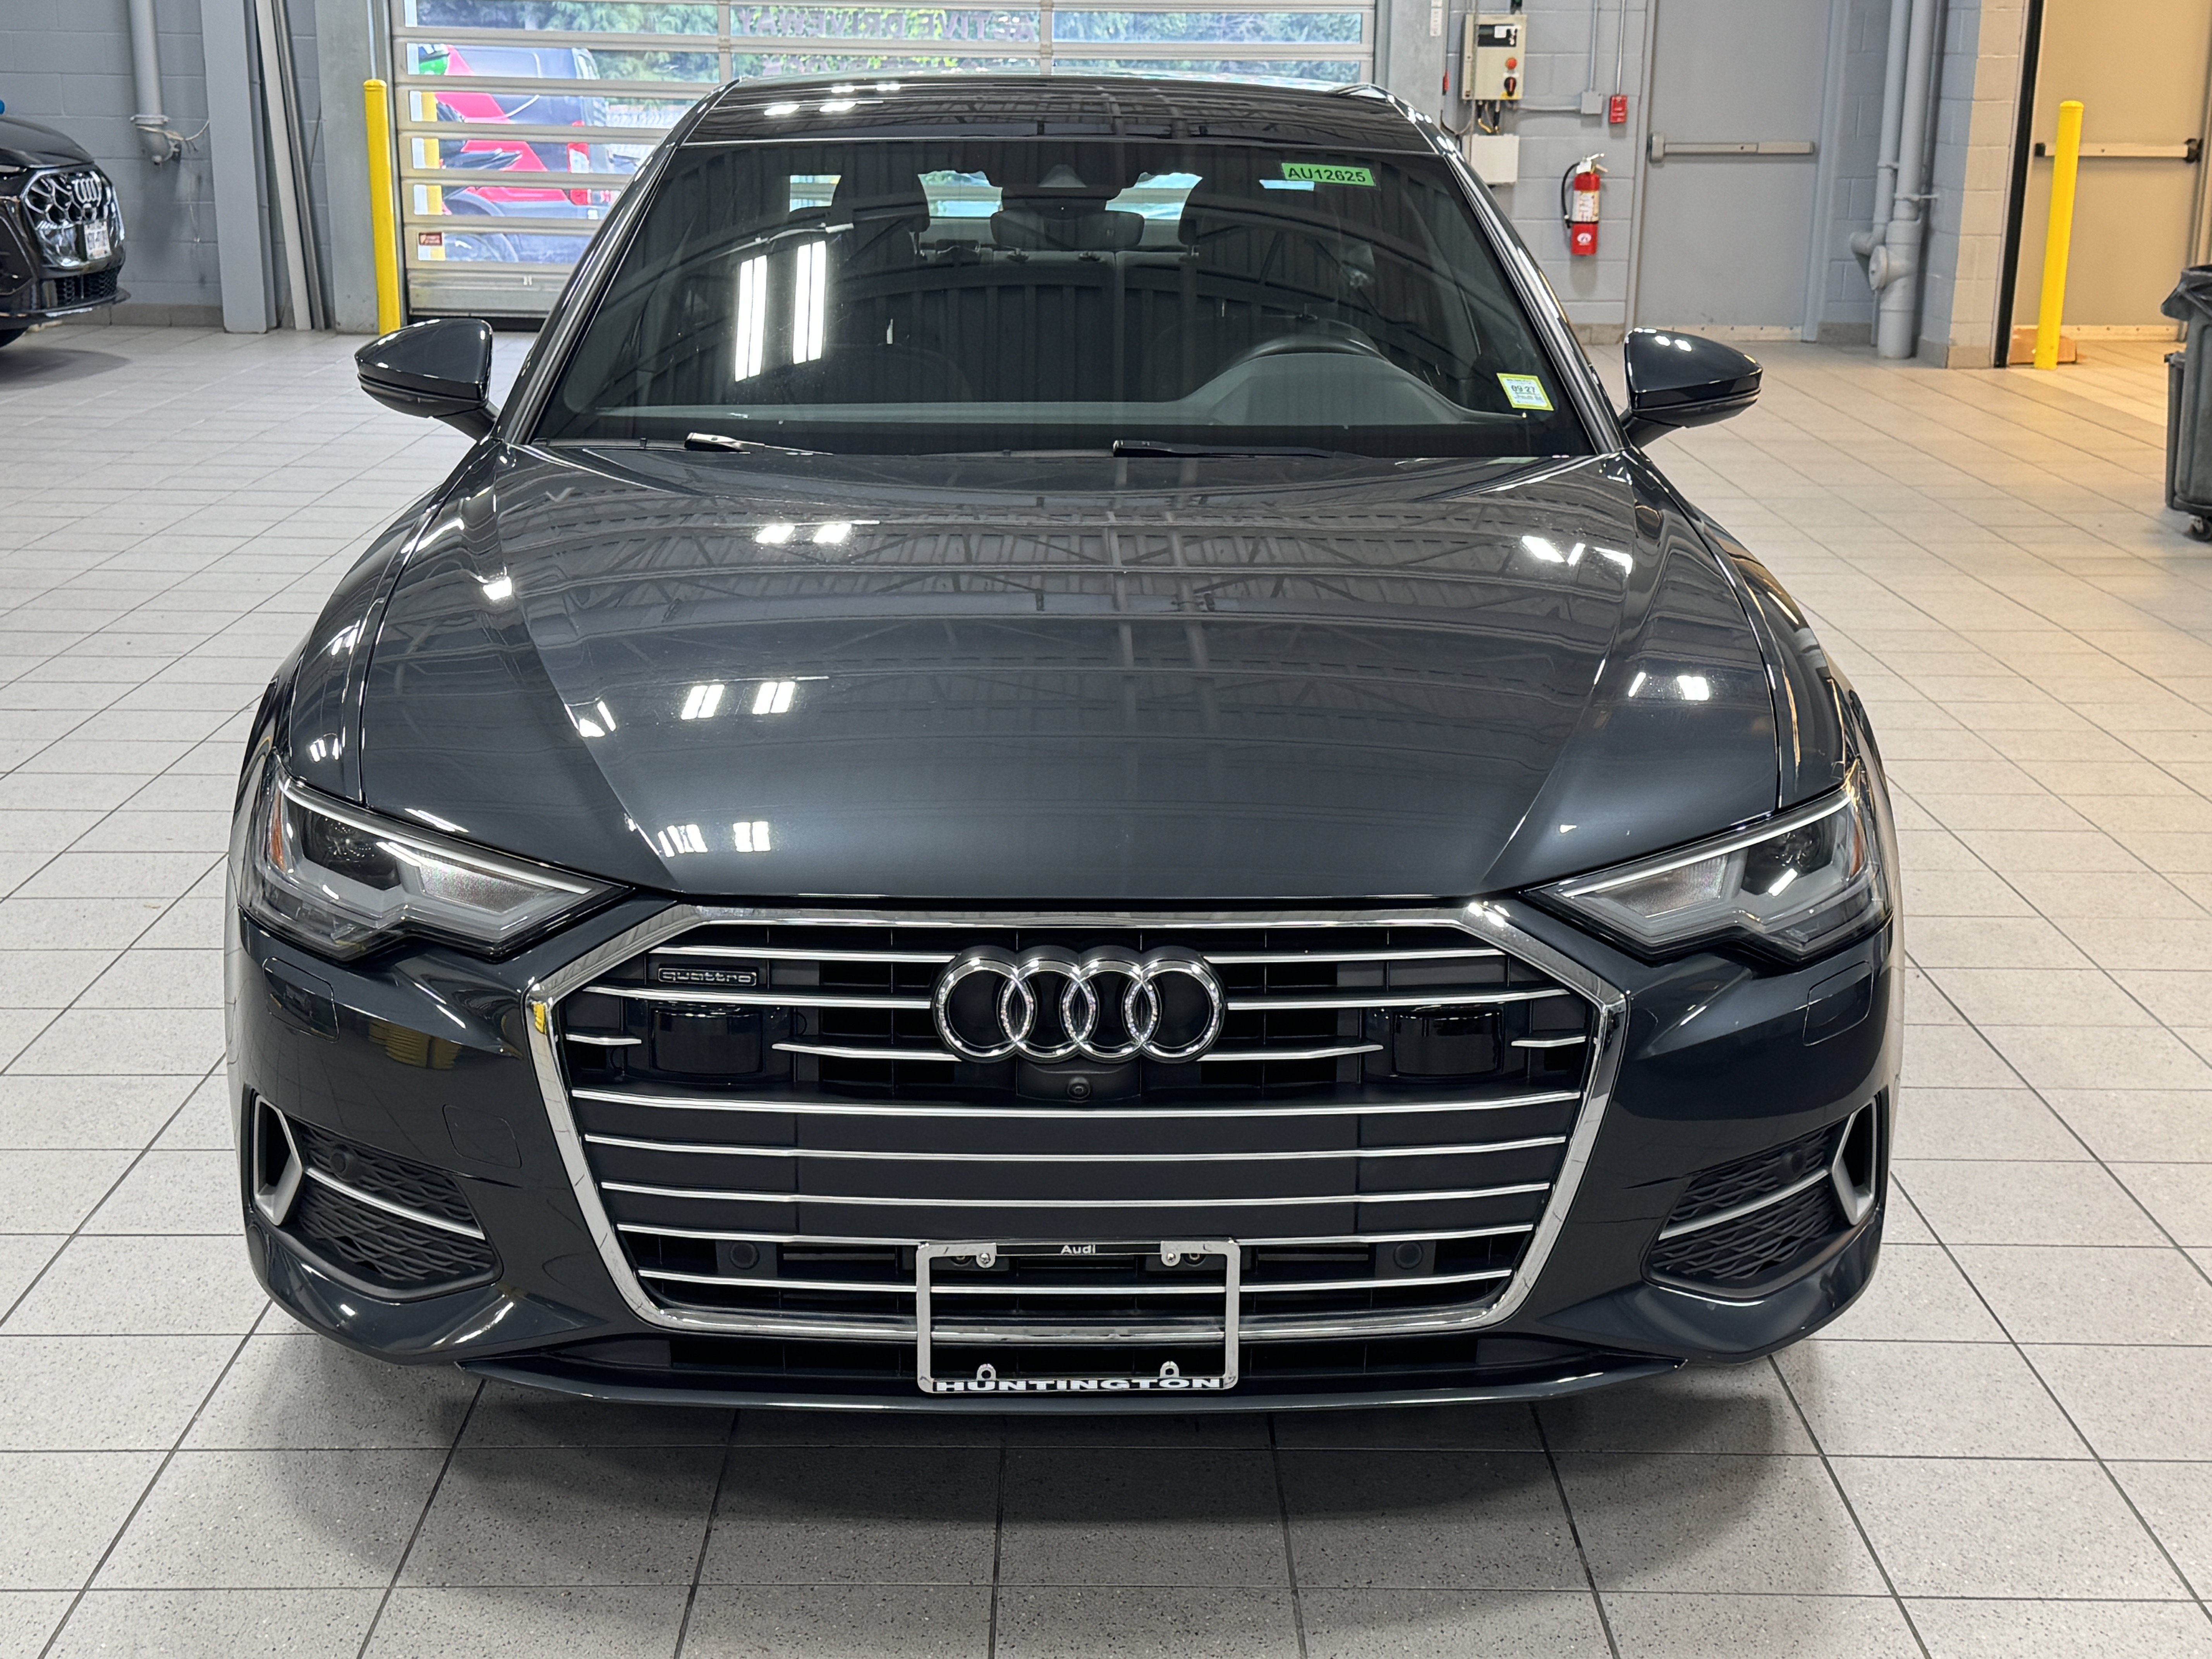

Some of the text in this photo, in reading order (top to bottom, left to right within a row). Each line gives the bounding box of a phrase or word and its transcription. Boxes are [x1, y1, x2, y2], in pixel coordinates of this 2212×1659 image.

[1288, 167, 1366, 182] AU12625
[662, 972, 751, 983] quattro
[1061, 1244, 1096, 1254] Audi
[936, 1378, 1220, 1391] HUNTINGTON
